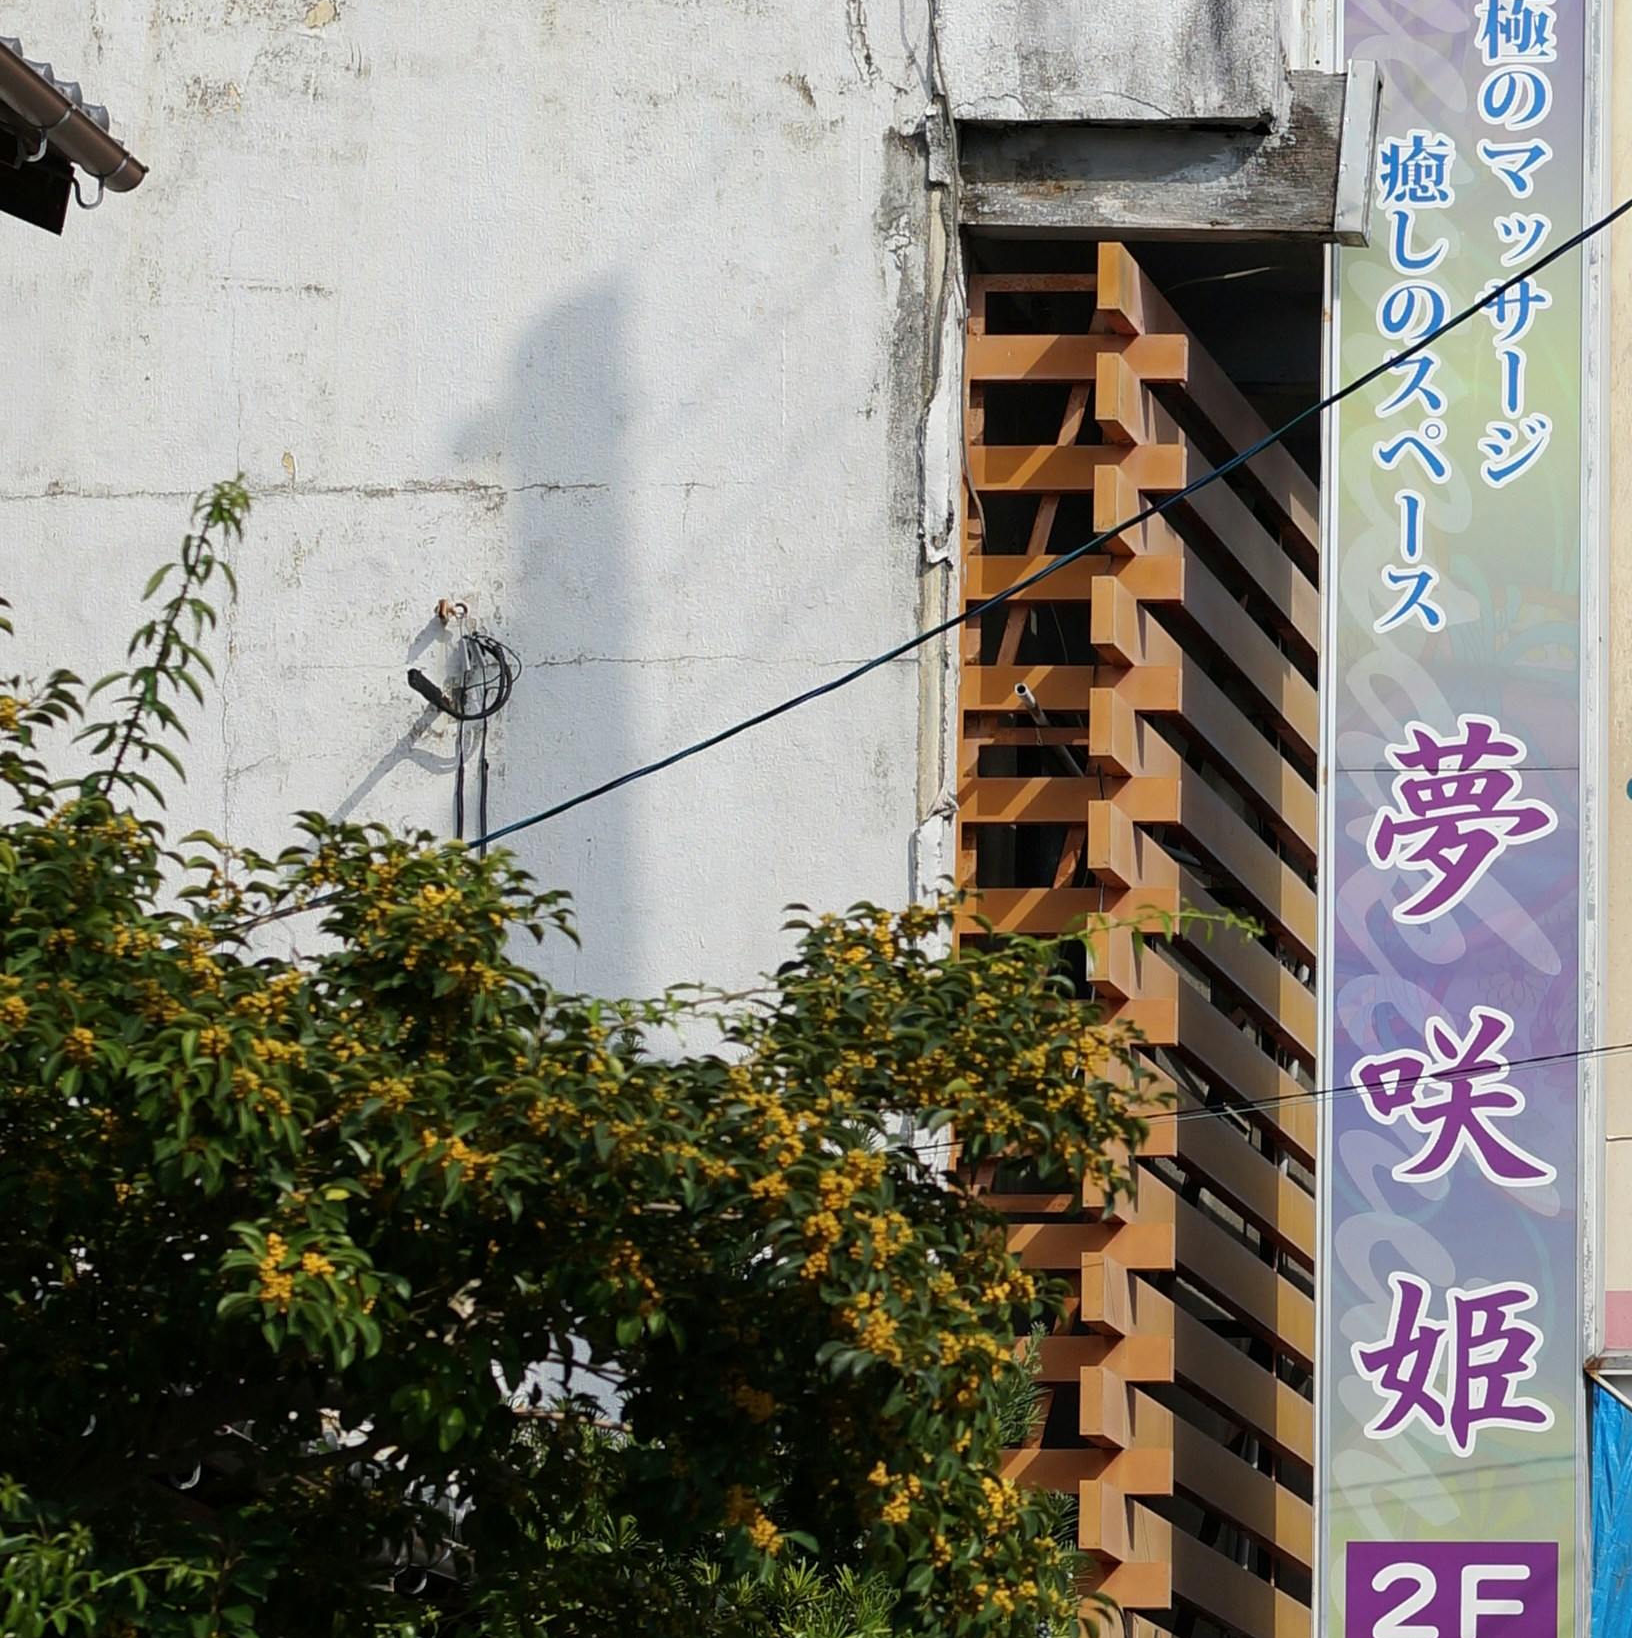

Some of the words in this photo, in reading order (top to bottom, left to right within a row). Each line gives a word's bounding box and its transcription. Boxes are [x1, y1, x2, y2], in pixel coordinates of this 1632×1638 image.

[1374, 130, 1456, 635] 癒しのスペース
[1350, 714, 1559, 1459] 夢咲姫
